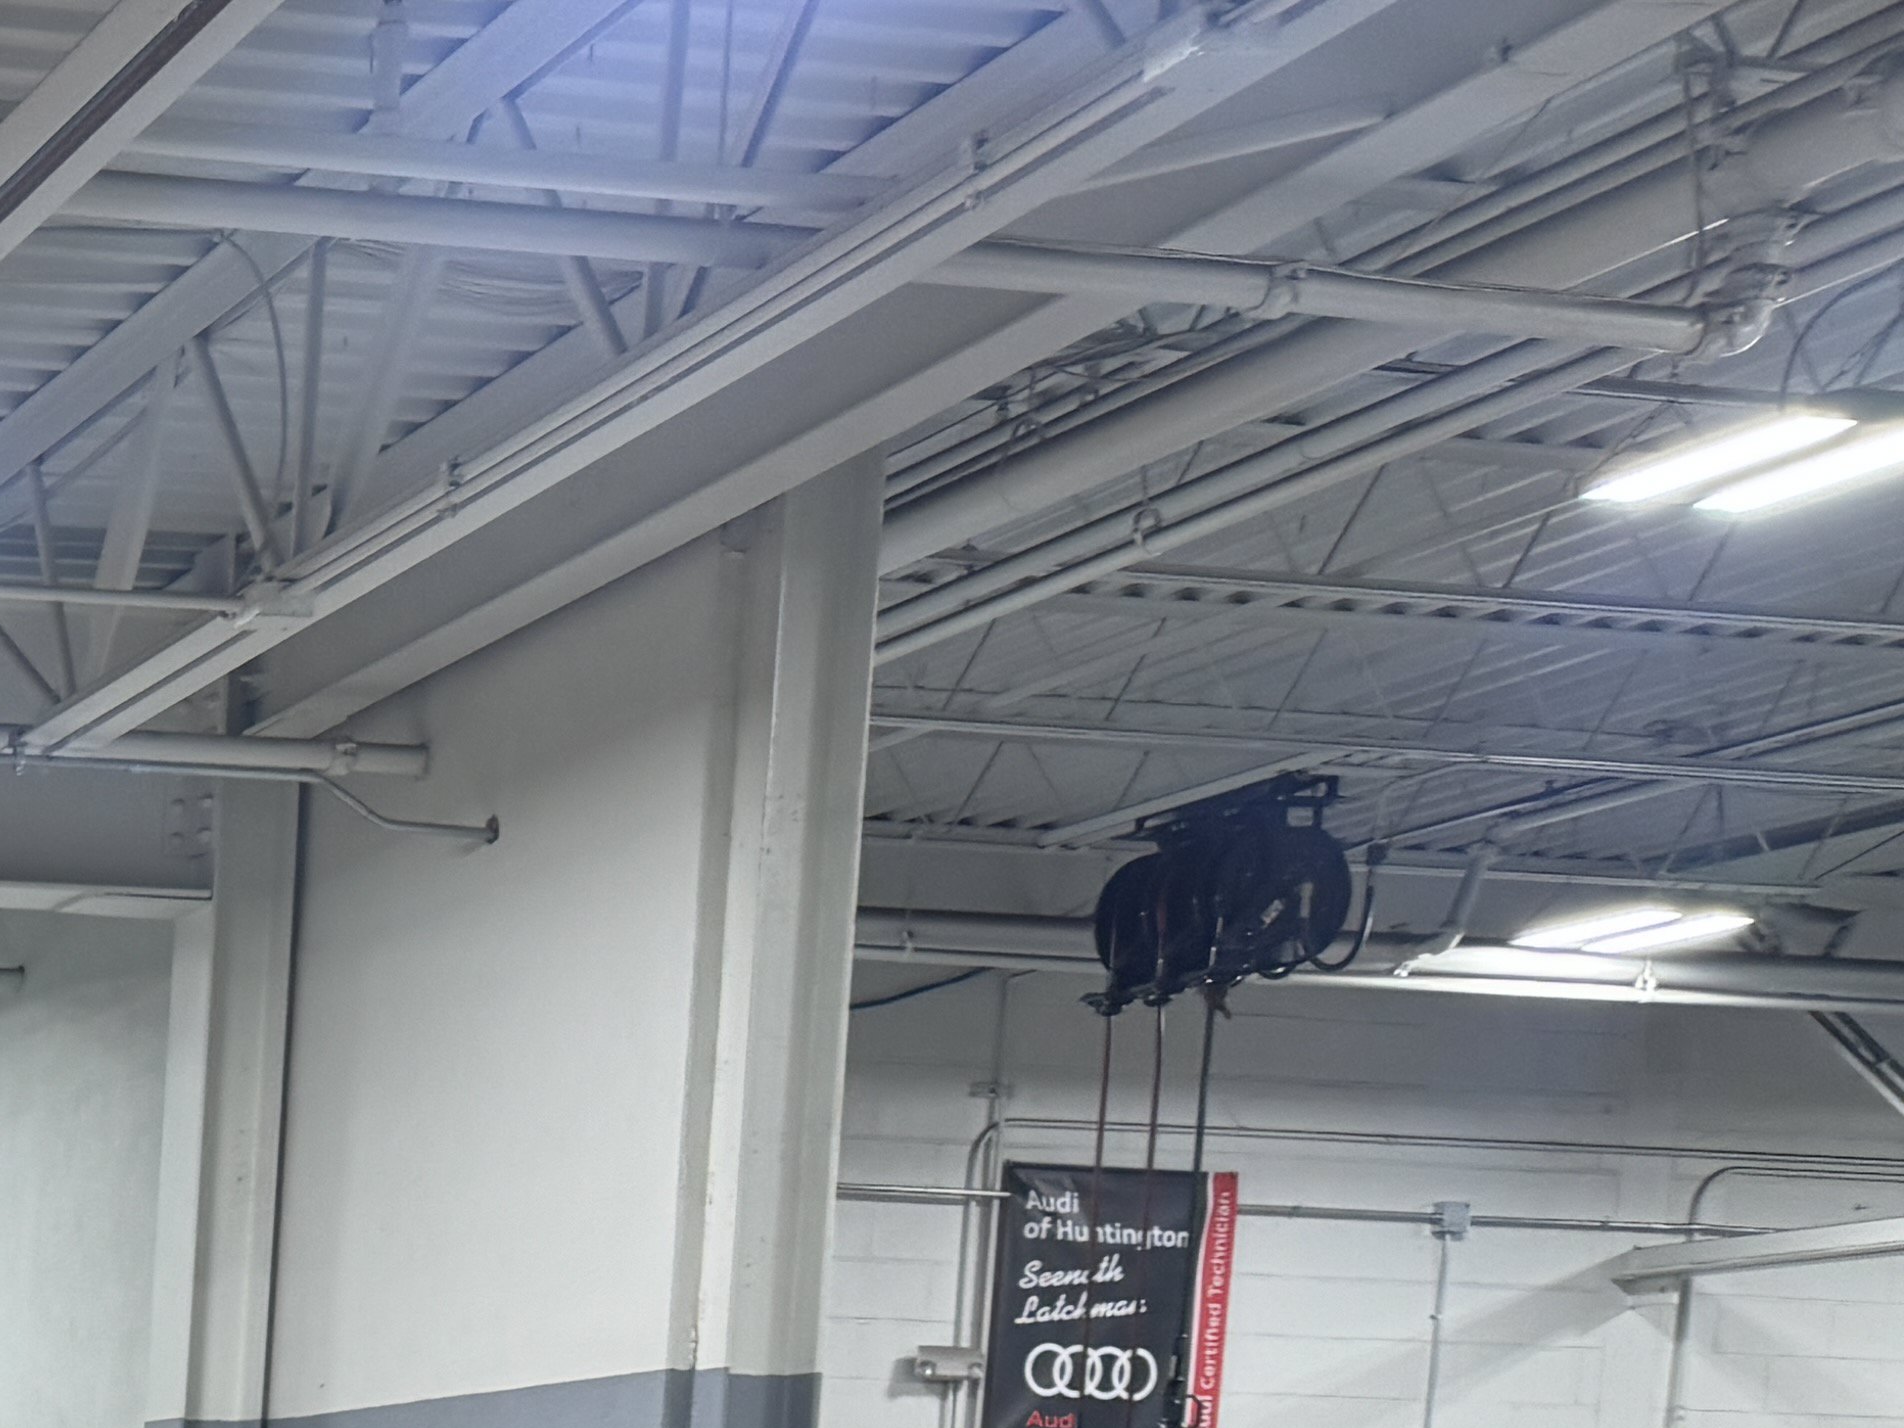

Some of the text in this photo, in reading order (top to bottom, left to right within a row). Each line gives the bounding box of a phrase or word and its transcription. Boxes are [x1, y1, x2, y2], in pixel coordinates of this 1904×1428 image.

[1023, 1216, 1052, 1239] of
[1025, 1190, 1079, 1213] Audi
[1208, 1191, 1231, 1298] Technician
[1200, 1303, 1223, 1389] Certified
